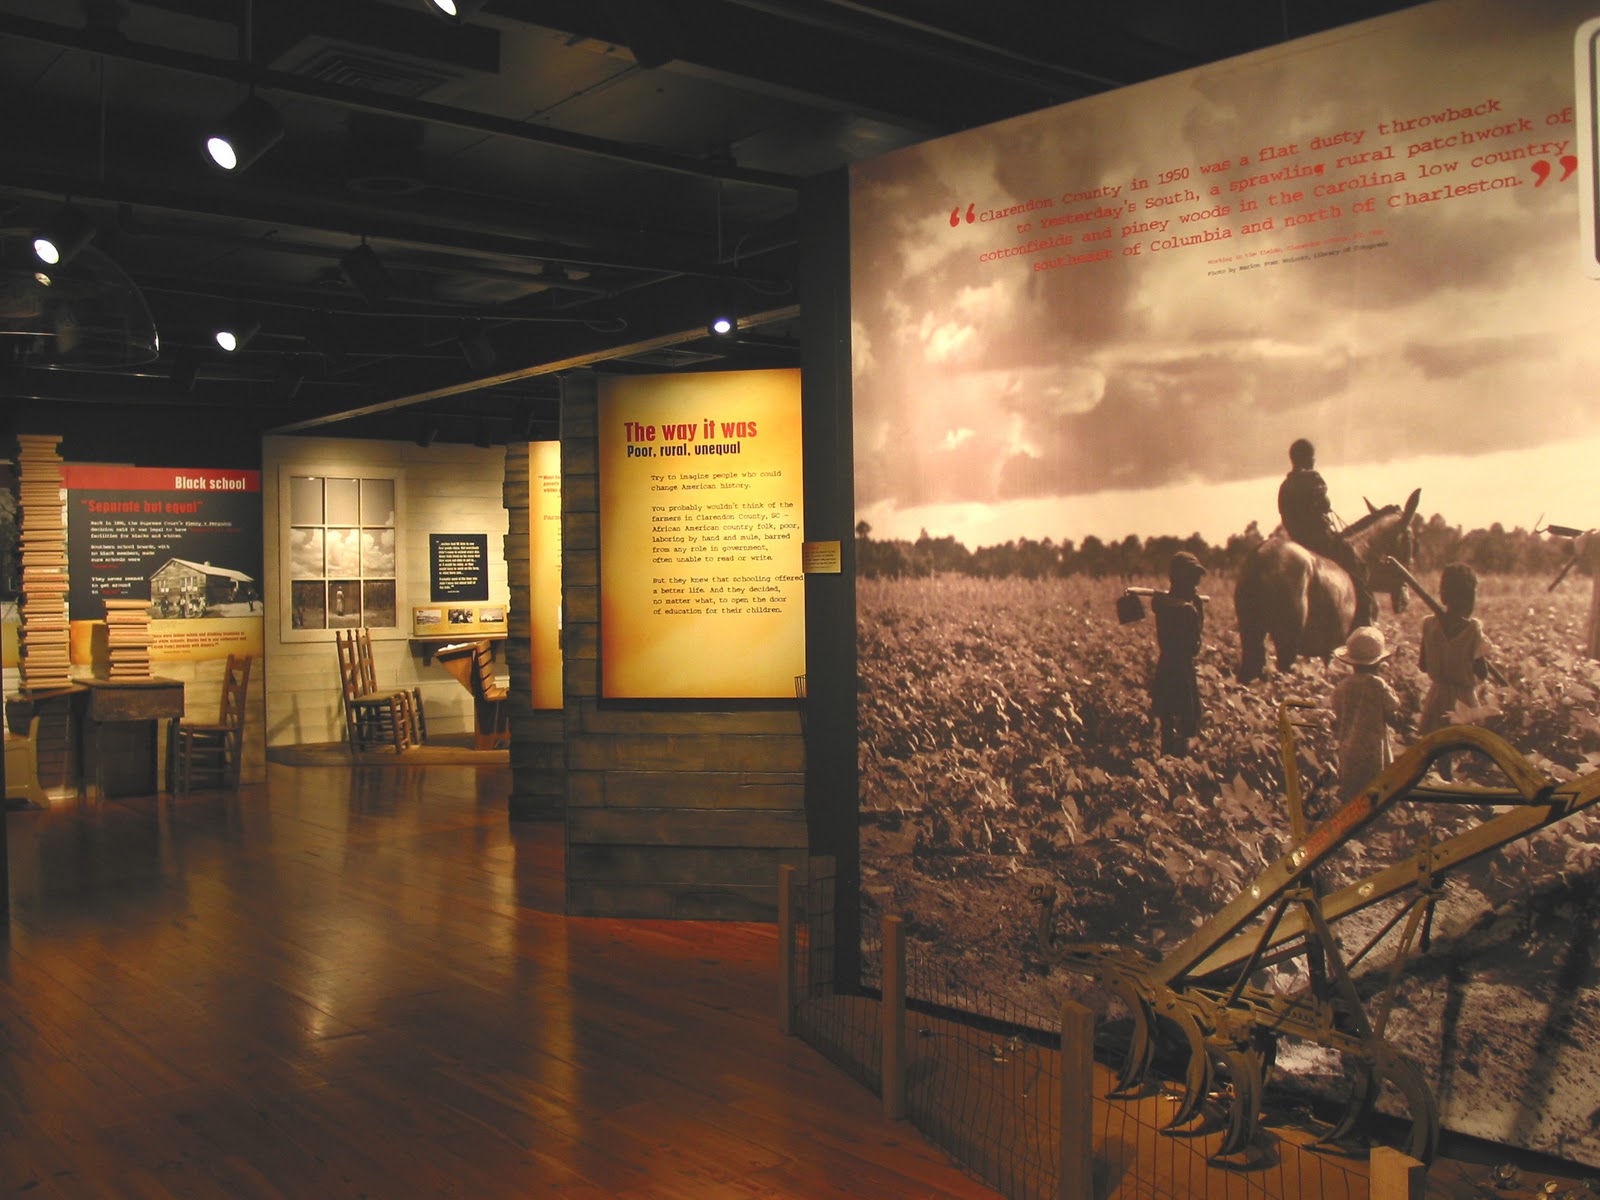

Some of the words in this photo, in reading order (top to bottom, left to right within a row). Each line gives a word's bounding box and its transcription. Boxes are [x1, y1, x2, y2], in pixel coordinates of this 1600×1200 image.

[1062, 185, 1122, 205] County
[1131, 178, 1149, 191] in
[1158, 167, 1190, 185] 1950
[1200, 160, 1231, 175] was
[1239, 156, 1249, 166] a
[1259, 144, 1298, 162] flat
[1310, 130, 1366, 151] dusty
[1378, 99, 1503, 135] throwback
[1016, 223, 1032, 234] to
[1040, 200, 1137, 229] Yesterday's
[1145, 189, 1200, 209] South,
[1210, 186, 1220, 196] a
[1230, 163, 1326, 193] sprawling
[1336, 146, 1395, 169] rural
[1407, 118, 1535, 158] patchwork
[1545, 107, 1573, 126] of
[979, 233, 1074, 263] cottonfields
[1082, 227, 1112, 243] and
[1121, 219, 1170, 238] piney
[1179, 205, 1231, 223] woods
[1240, 199, 1258, 213] in
[1268, 191, 1304, 206] the
[1313, 171, 1406, 198] Carolina
[1418, 161, 1459, 179] low
[1470, 140, 1570, 168] country
[1033, 249, 1113, 272] southeast
[1122, 242, 1142, 256] of
[1150, 227, 1233, 252] Columbia
[1241, 217, 1274, 235] and
[1284, 205, 1343, 228] north
[1352, 197, 1376, 214] of
[624, 422, 656, 443] The
[662, 423, 698, 442] way
[703, 418, 715, 439] it
[721, 421, 757, 438] was
[627, 445, 657, 458] Poor,
[660, 443, 691, 457] rural,
[695, 441, 741, 456] unequal
[651, 474, 664, 482] Try
[680, 472, 709, 481] imagine
[712, 471, 738, 479] people
[741, 470, 757, 478] who
[760, 470, 782, 478] could
[175, 476, 206, 489] Black
[209, 477, 246, 490] school
[651, 483, 678, 492] change
[681, 482, 717, 491] American
[720, 481, 752, 490] history.
[144, 500, 162, 513] but
[668, 503, 703, 513] probably
[706, 502, 739, 510] wouldn't
[742, 501, 765, 509] think
[767, 501, 776, 509] of
[696, 513, 735, 521] Clarendon
[738, 513, 768, 521] County,
[652, 525, 681, 533] African
[684, 524, 719, 532] American
[757, 522, 776, 530] folk,
[652, 535, 685, 543] laboring
[688, 535, 697, 543] by
[652, 556, 673, 564] often
[676, 555, 702, 563] unable
[668, 576, 687, 585] they
[727, 586, 745, 594] they
[749, 585, 781, 593] decided,
[695, 597, 716, 605] what,
